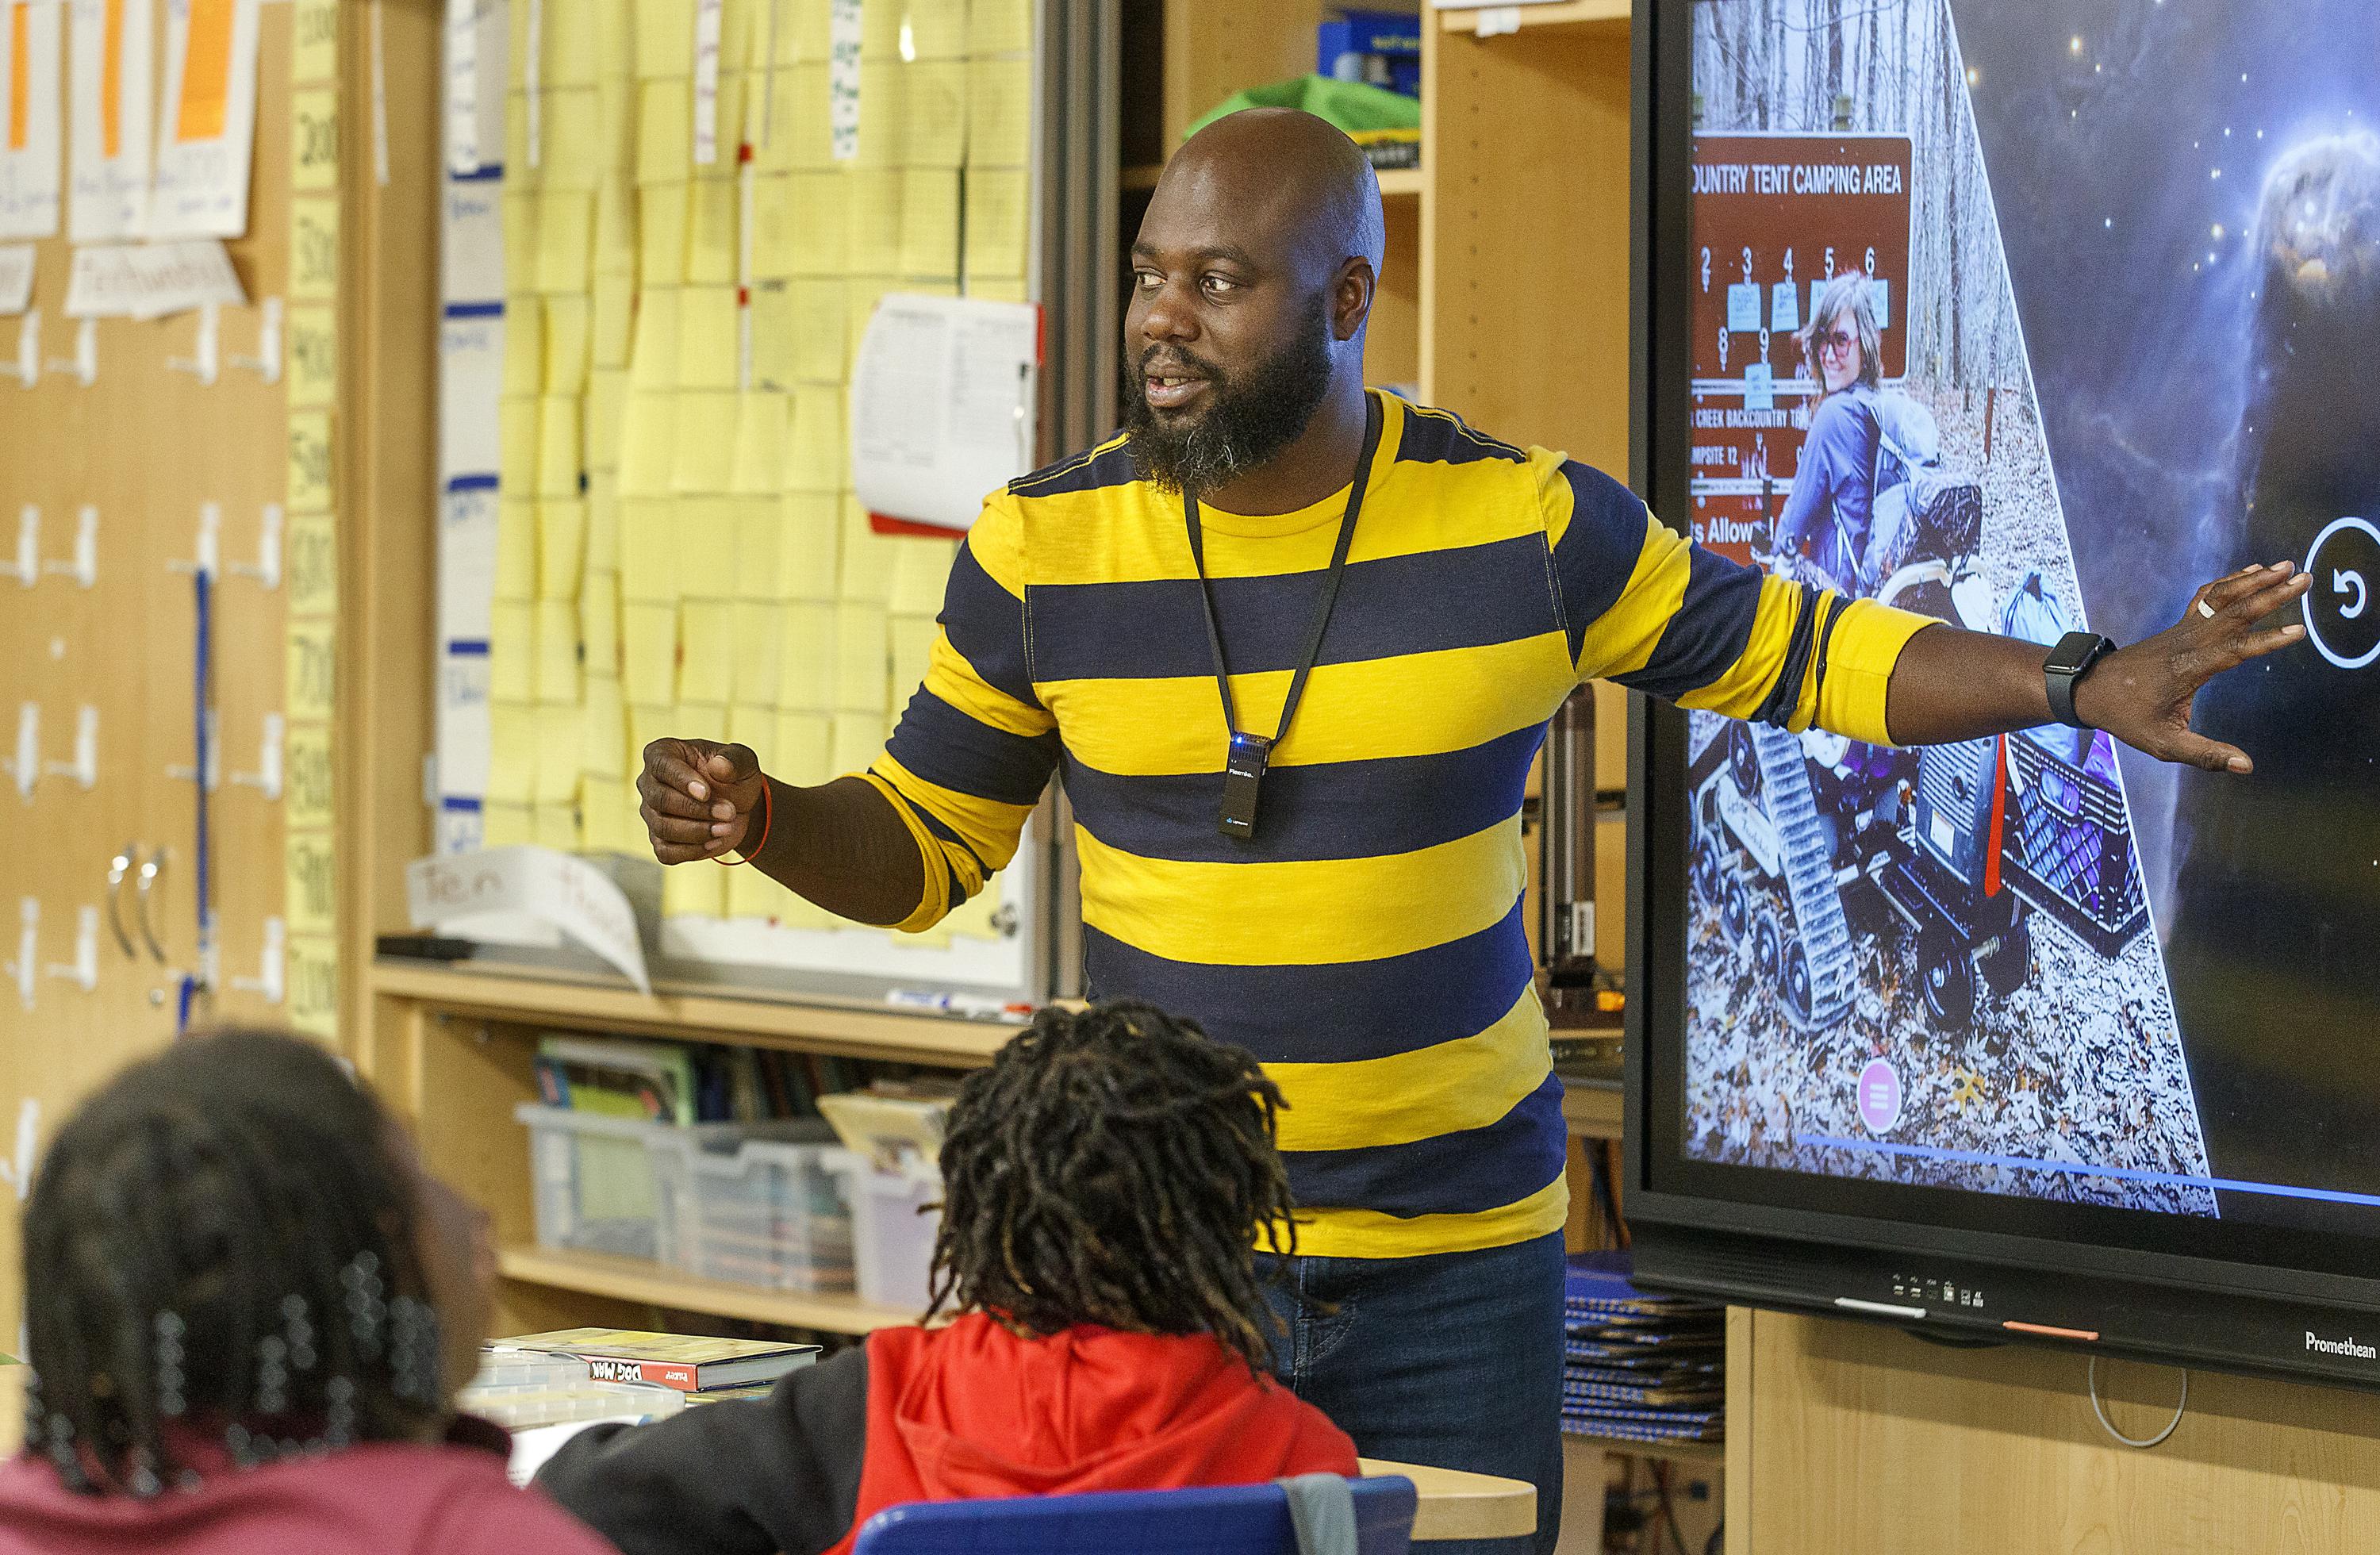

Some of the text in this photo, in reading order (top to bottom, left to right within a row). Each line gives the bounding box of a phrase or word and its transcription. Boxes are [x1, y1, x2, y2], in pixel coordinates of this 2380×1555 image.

[1751, 164, 1791, 194] TENT
[1793, 164, 1860, 194] CAMPING
[1863, 164, 1902, 194] AREA
[1741, 246, 1752, 275] 3
[1783, 247, 1794, 276] 4
[1825, 247, 1834, 275] 5
[1865, 246, 1875, 275] 6
[1718, 325, 1770, 354] 8 9
[1695, 409, 1724, 428] CREEK
[1727, 445, 1738, 466] 12
[2305, 1330, 2377, 1359] Promethean
[591, 1361, 643, 1381] DOG MAN
